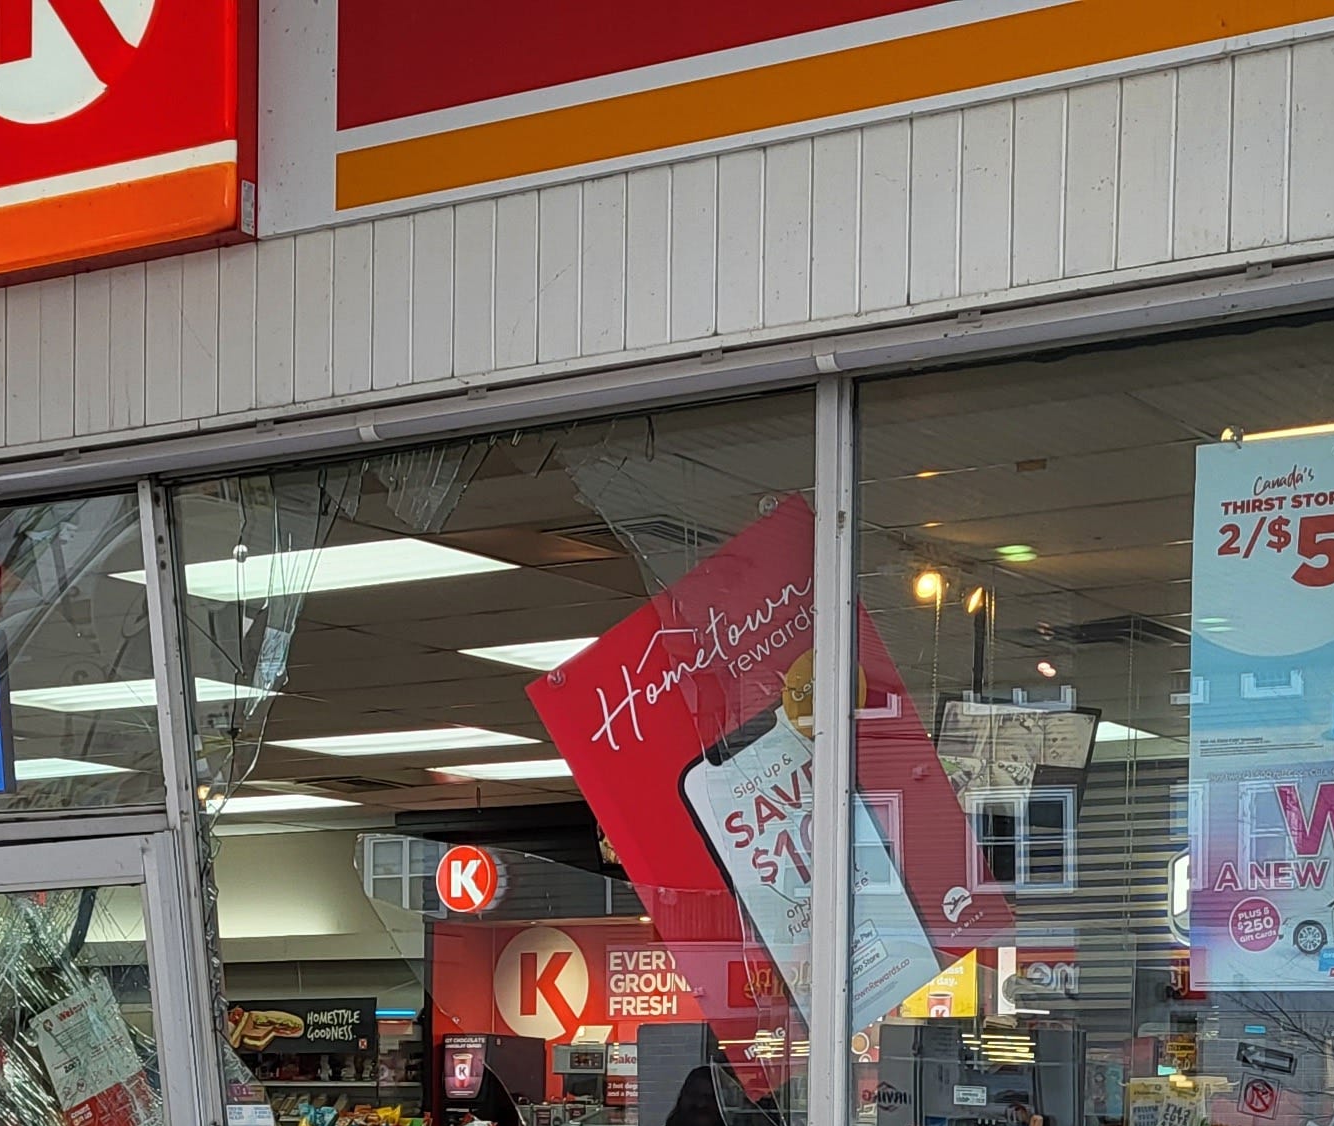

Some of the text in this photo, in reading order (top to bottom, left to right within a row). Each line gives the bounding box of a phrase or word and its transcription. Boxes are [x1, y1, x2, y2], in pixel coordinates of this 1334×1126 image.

[1254, 464, 1315, 496] Canada's
[1221, 496, 1287, 516] THIRST
[727, 604, 819, 679] rewards
[591, 577, 813, 751] Hometown
[733, 752, 793, 799] Sign up &
[1215, 860, 1241, 892] A
[1248, 858, 1330, 890] NEW
[1237, 916, 1274, 934] $250
[854, 958, 911, 1001] ownRewards.co
[306, 1009, 361, 1026] HOMESTYLE
[608, 995, 678, 1017] FRESH
[306, 1025, 358, 1042] GOODNESS.
